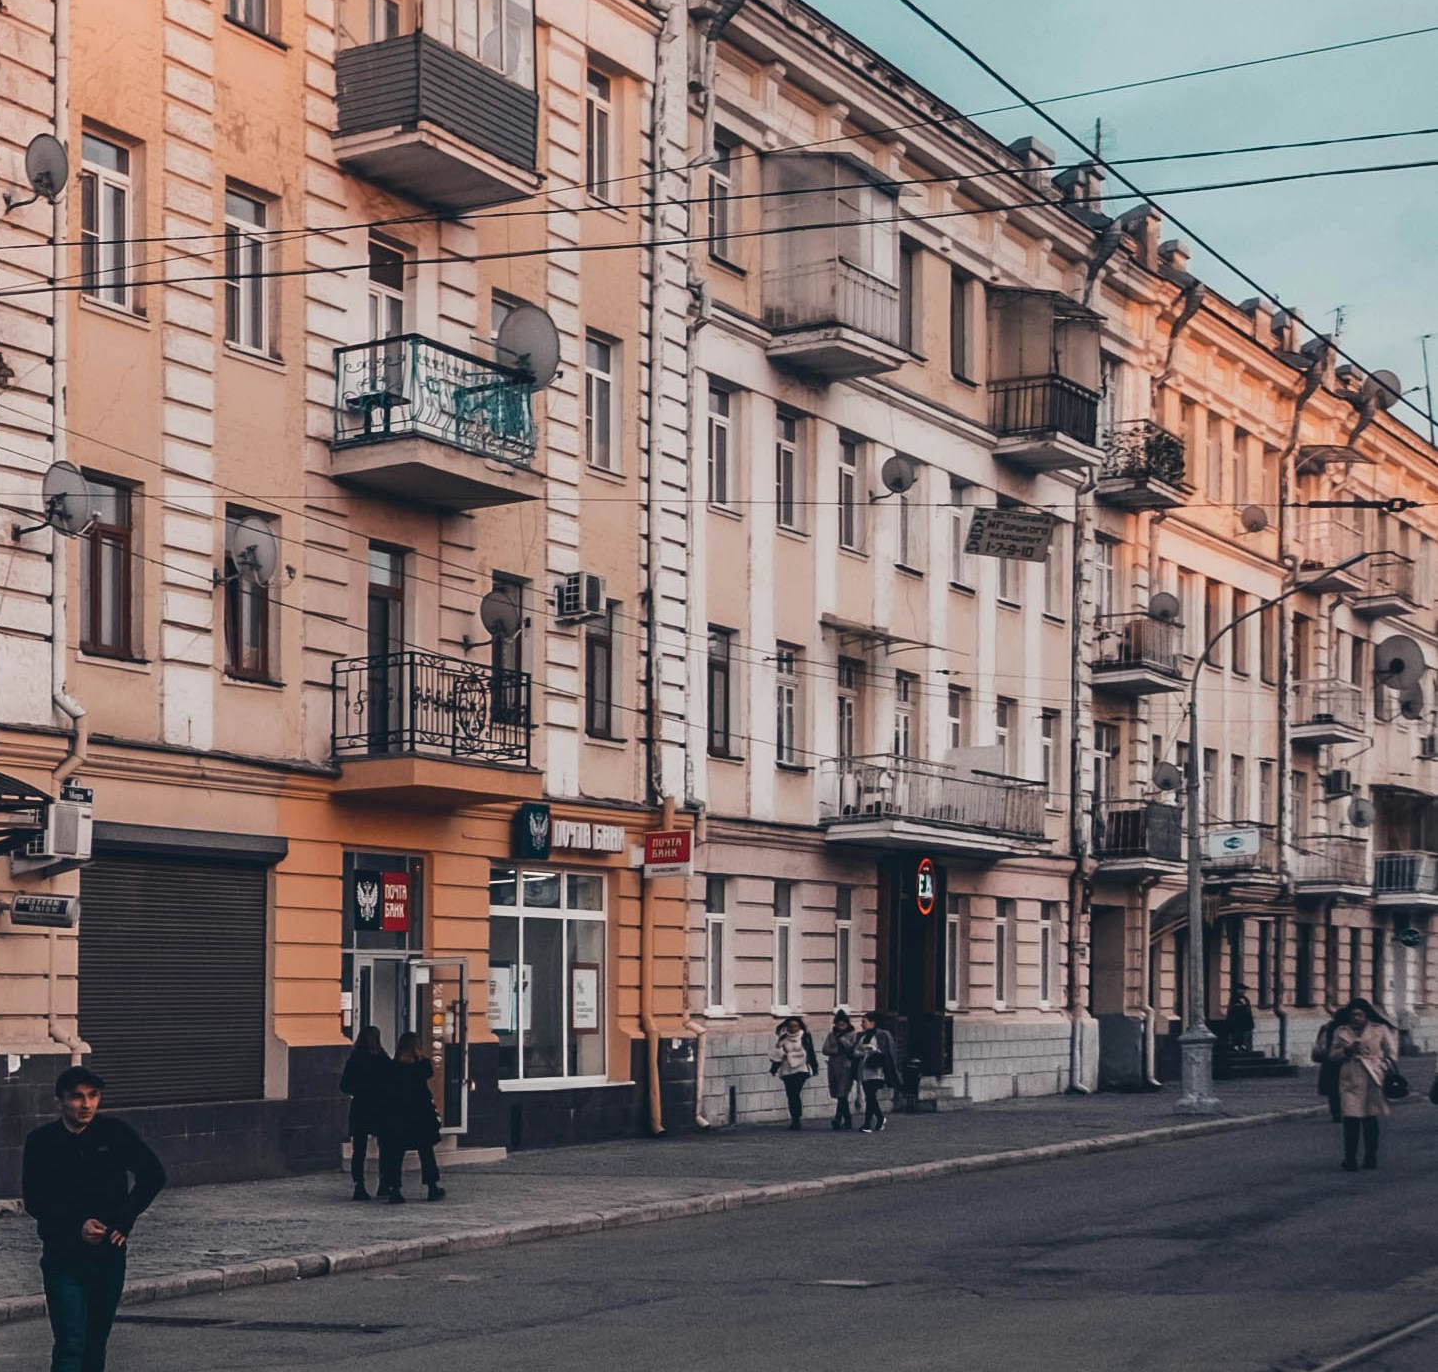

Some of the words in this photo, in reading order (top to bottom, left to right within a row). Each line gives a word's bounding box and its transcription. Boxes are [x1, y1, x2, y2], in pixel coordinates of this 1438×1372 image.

[551, 819, 591, 849] ПОЧТА
[592, 823, 625, 852] БАНК
[652, 837, 682, 848] ПОЧТА
[652, 849, 678, 858] БАНК
[384, 884, 407, 900] ПОЧТА
[384, 902, 404, 918] БАНК
